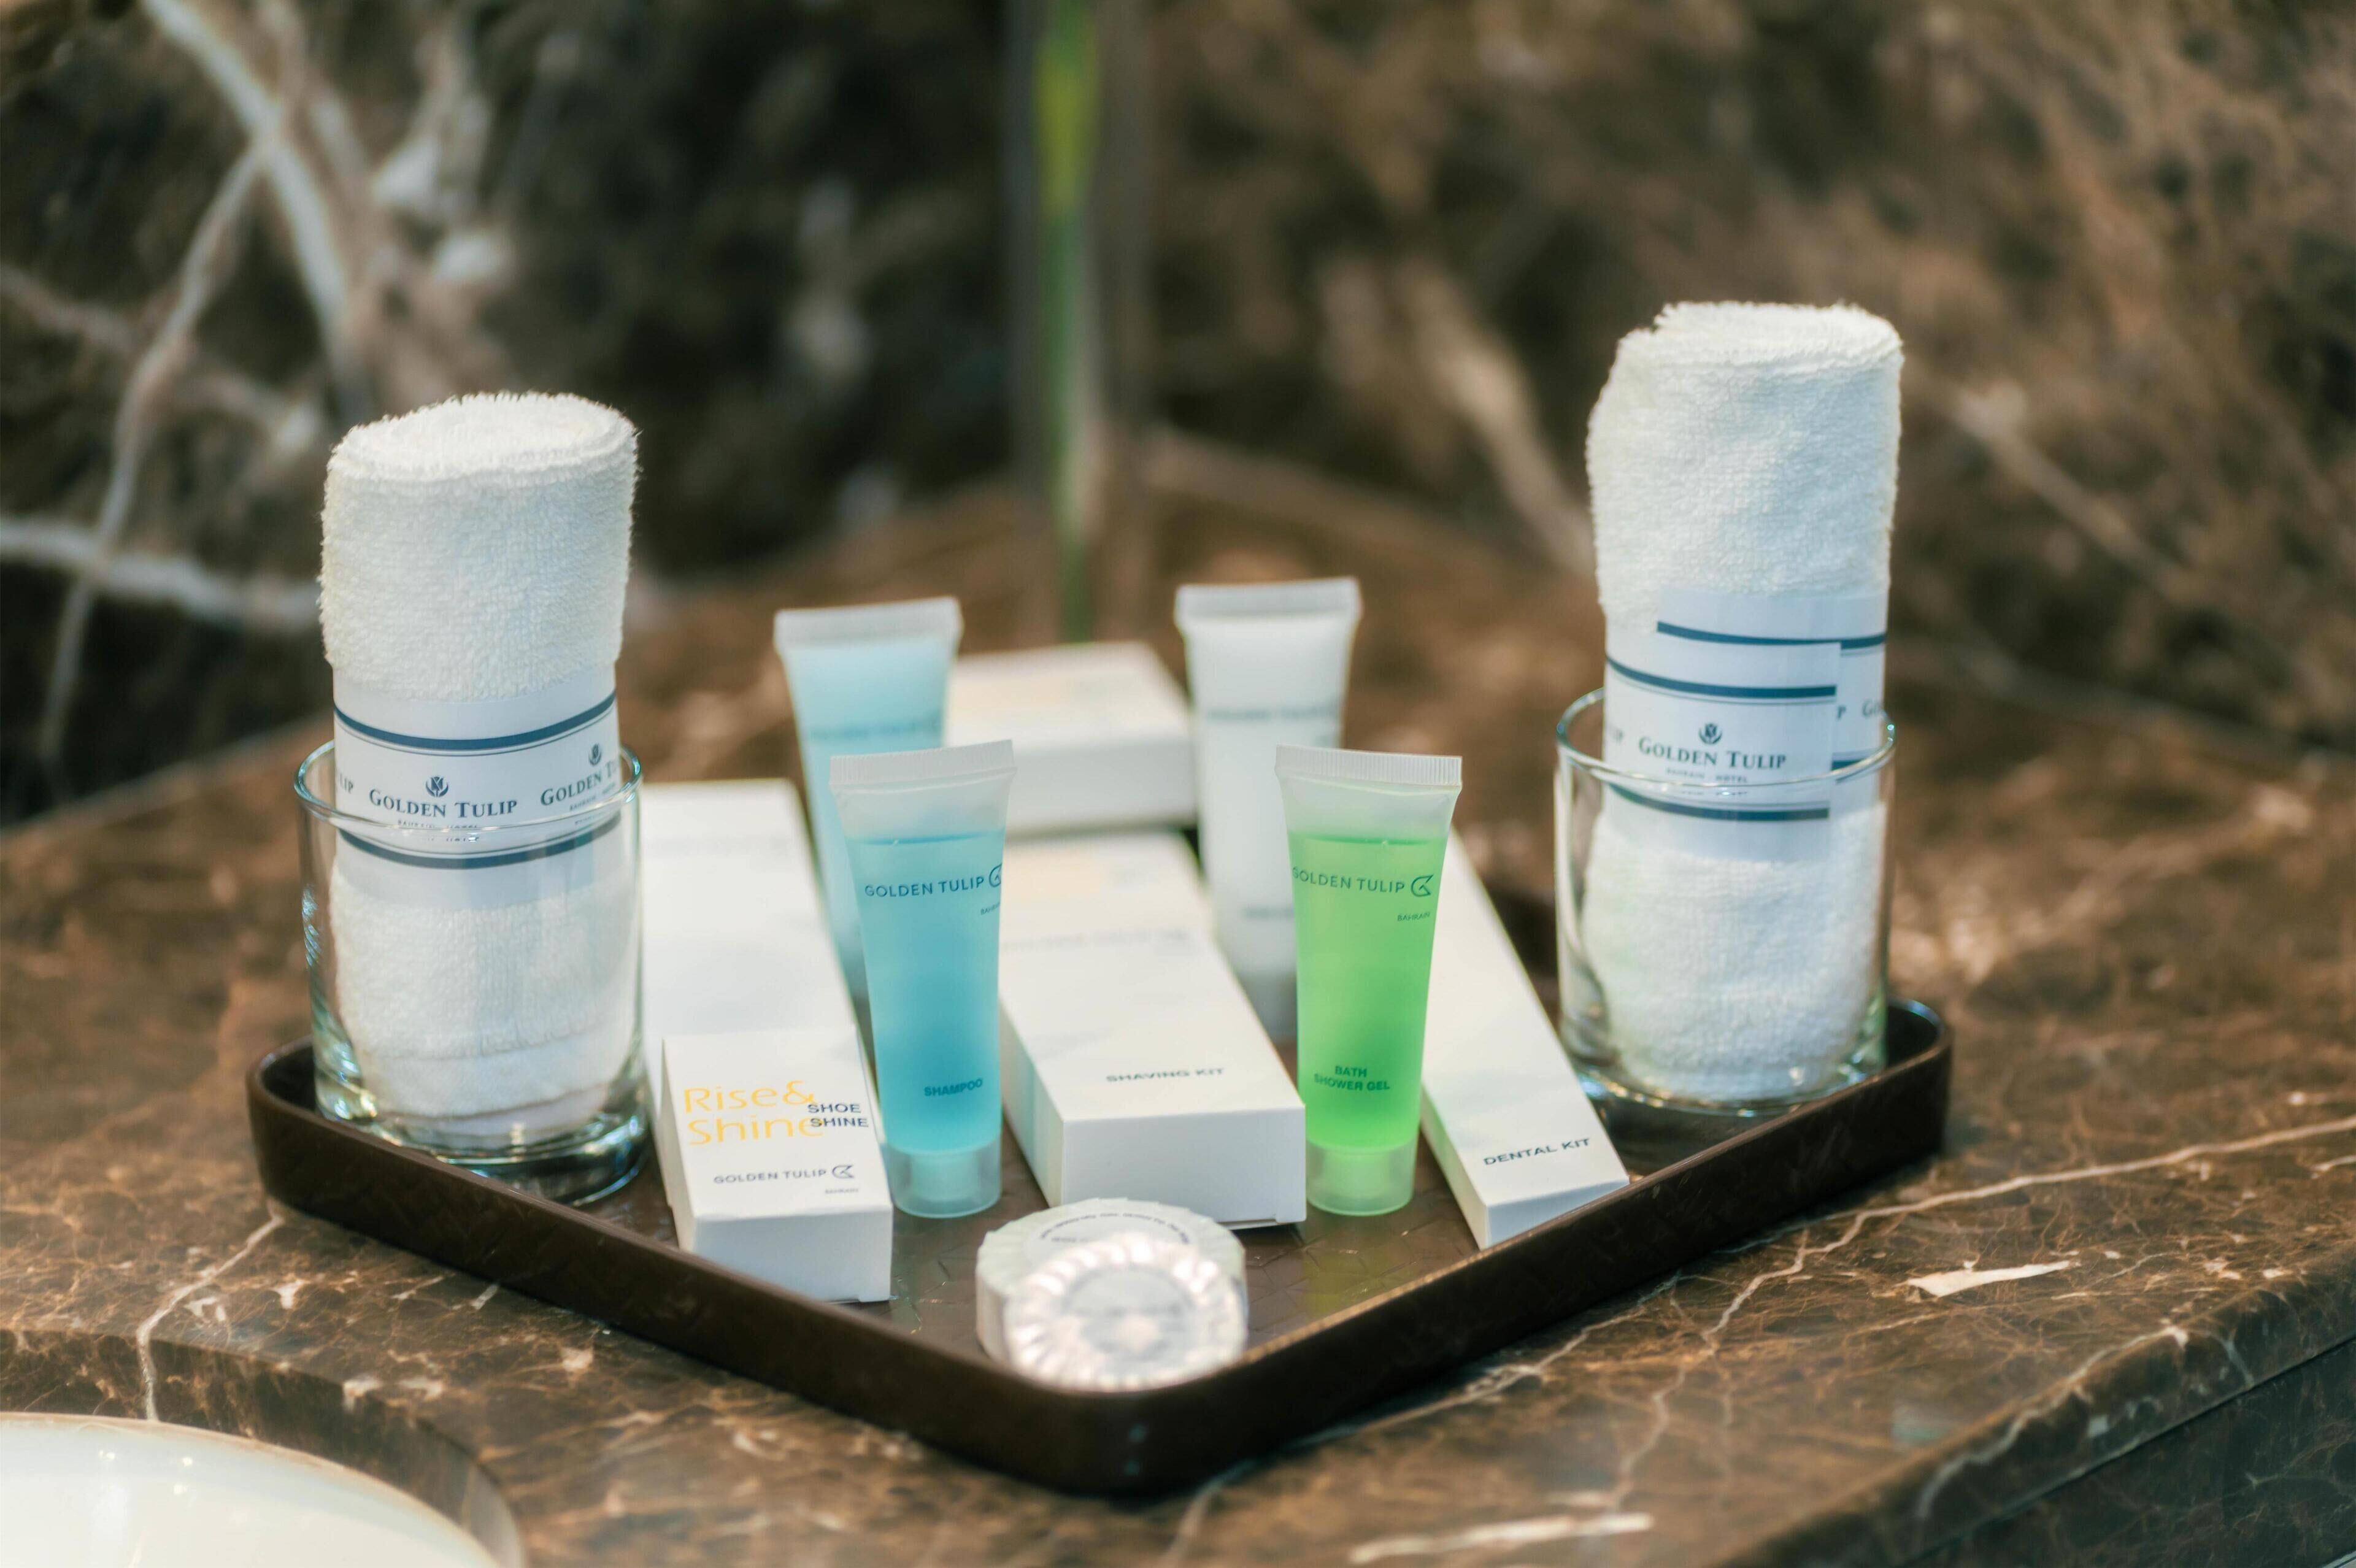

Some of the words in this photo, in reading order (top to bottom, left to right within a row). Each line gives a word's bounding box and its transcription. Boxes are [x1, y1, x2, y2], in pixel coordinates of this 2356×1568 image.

[1638, 736, 1717, 766] GOLDEN
[1726, 750, 1787, 770] TULIP
[540, 769, 602, 806] GOLDEN
[369, 788, 447, 818] GOLDEN
[454, 799, 517, 818] TULIP
[864, 882, 933, 897] GOLDEN
[937, 875, 985, 894] TULIP
[1292, 866, 1351, 890] GOLDEN
[1356, 878, 1405, 893] TULIP
[1396, 911, 1431, 921] BAHRAIN
[1106, 1070, 1191, 1083] SHAVING
[1195, 1067, 1226, 1077] KIT
[1314, 1072, 1363, 1091] SHOWER
[1366, 1080, 1391, 1091] GEL
[1334, 1065, 1368, 1078] BATH
[683, 1079, 816, 1115] Rise&
[923, 1077, 984, 1097] SHAMPOO
[807, 1102, 861, 1114] SHOE
[687, 1114, 826, 1146] Shine
[810, 1116, 869, 1128] SHINE
[1483, 1144, 1558, 1166] DENTAL
[1561, 1137, 1591, 1150] KIT
[713, 1172, 779, 1185] GOLDEN
[782, 1168, 827, 1179] TULIP
